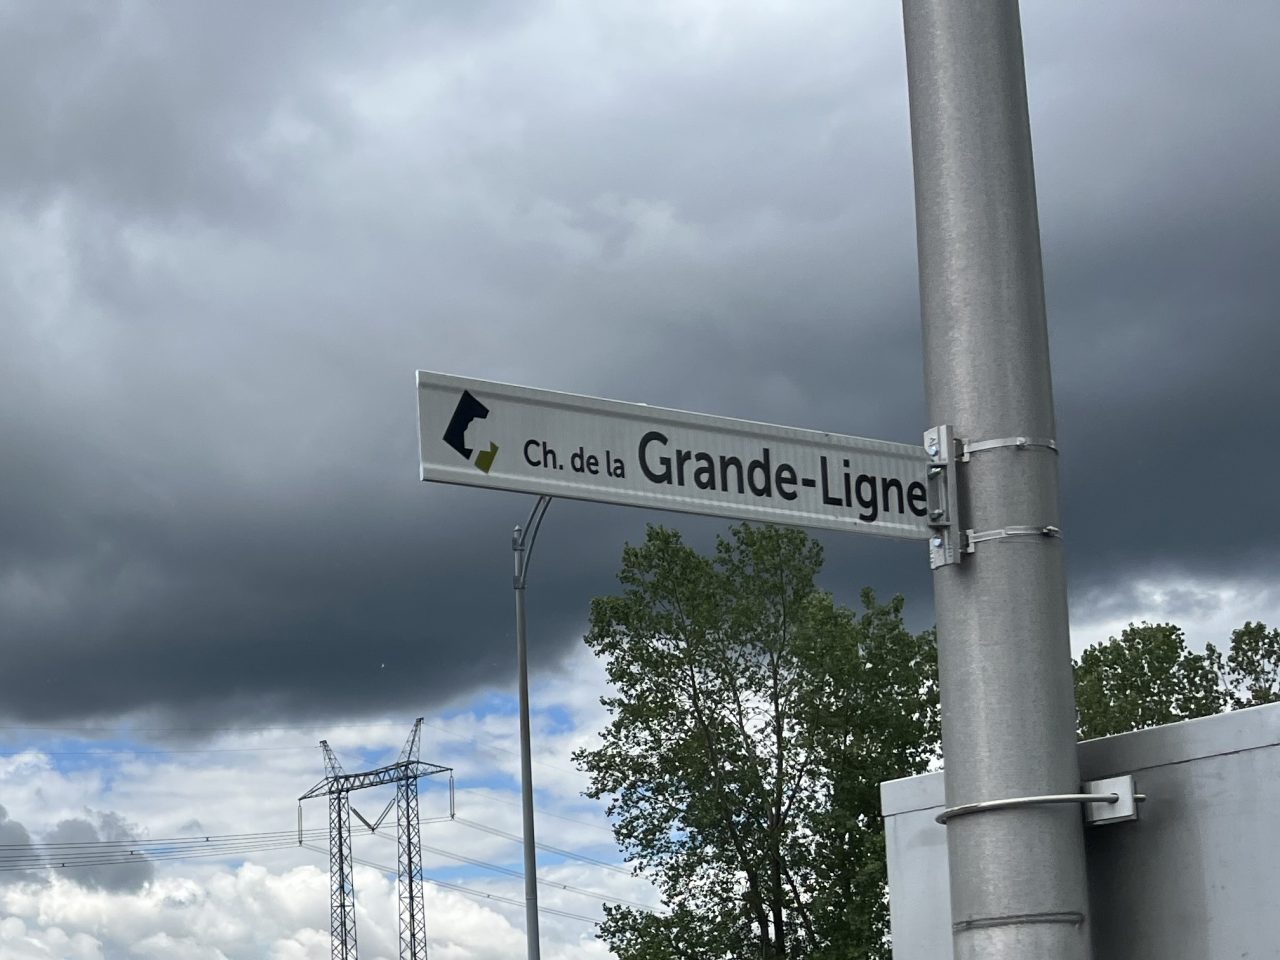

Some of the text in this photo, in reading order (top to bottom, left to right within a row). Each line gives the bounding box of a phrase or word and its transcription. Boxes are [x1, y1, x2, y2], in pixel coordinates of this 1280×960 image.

[523, 430, 928, 523] Ch. de la Grande-Ligne
